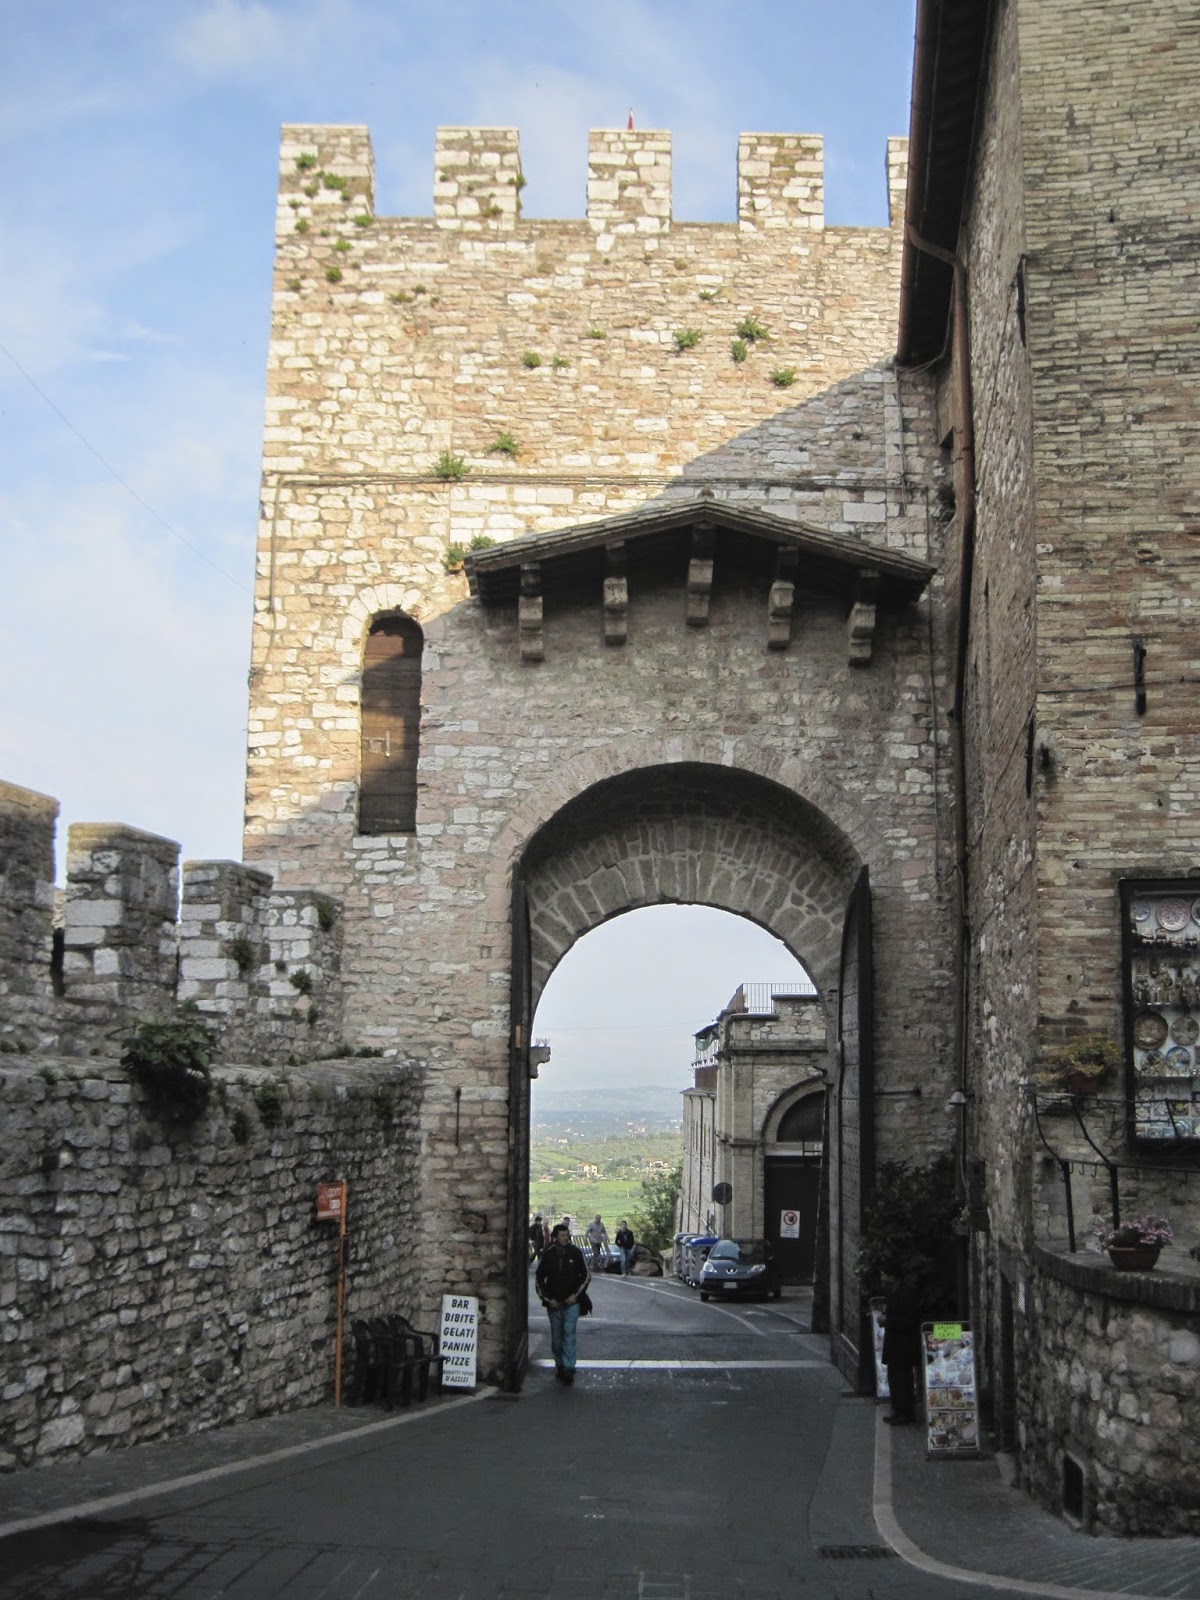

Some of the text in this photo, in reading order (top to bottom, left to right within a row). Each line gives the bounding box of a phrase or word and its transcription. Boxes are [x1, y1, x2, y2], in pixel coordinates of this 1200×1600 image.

[451, 1299, 469, 1309] BAR
[444, 1313, 475, 1324] BIBITE
[443, 1327, 475, 1338] GELATI
[442, 1341, 475, 1352] PANINI
[445, 1356, 470, 1366] PIZZE
